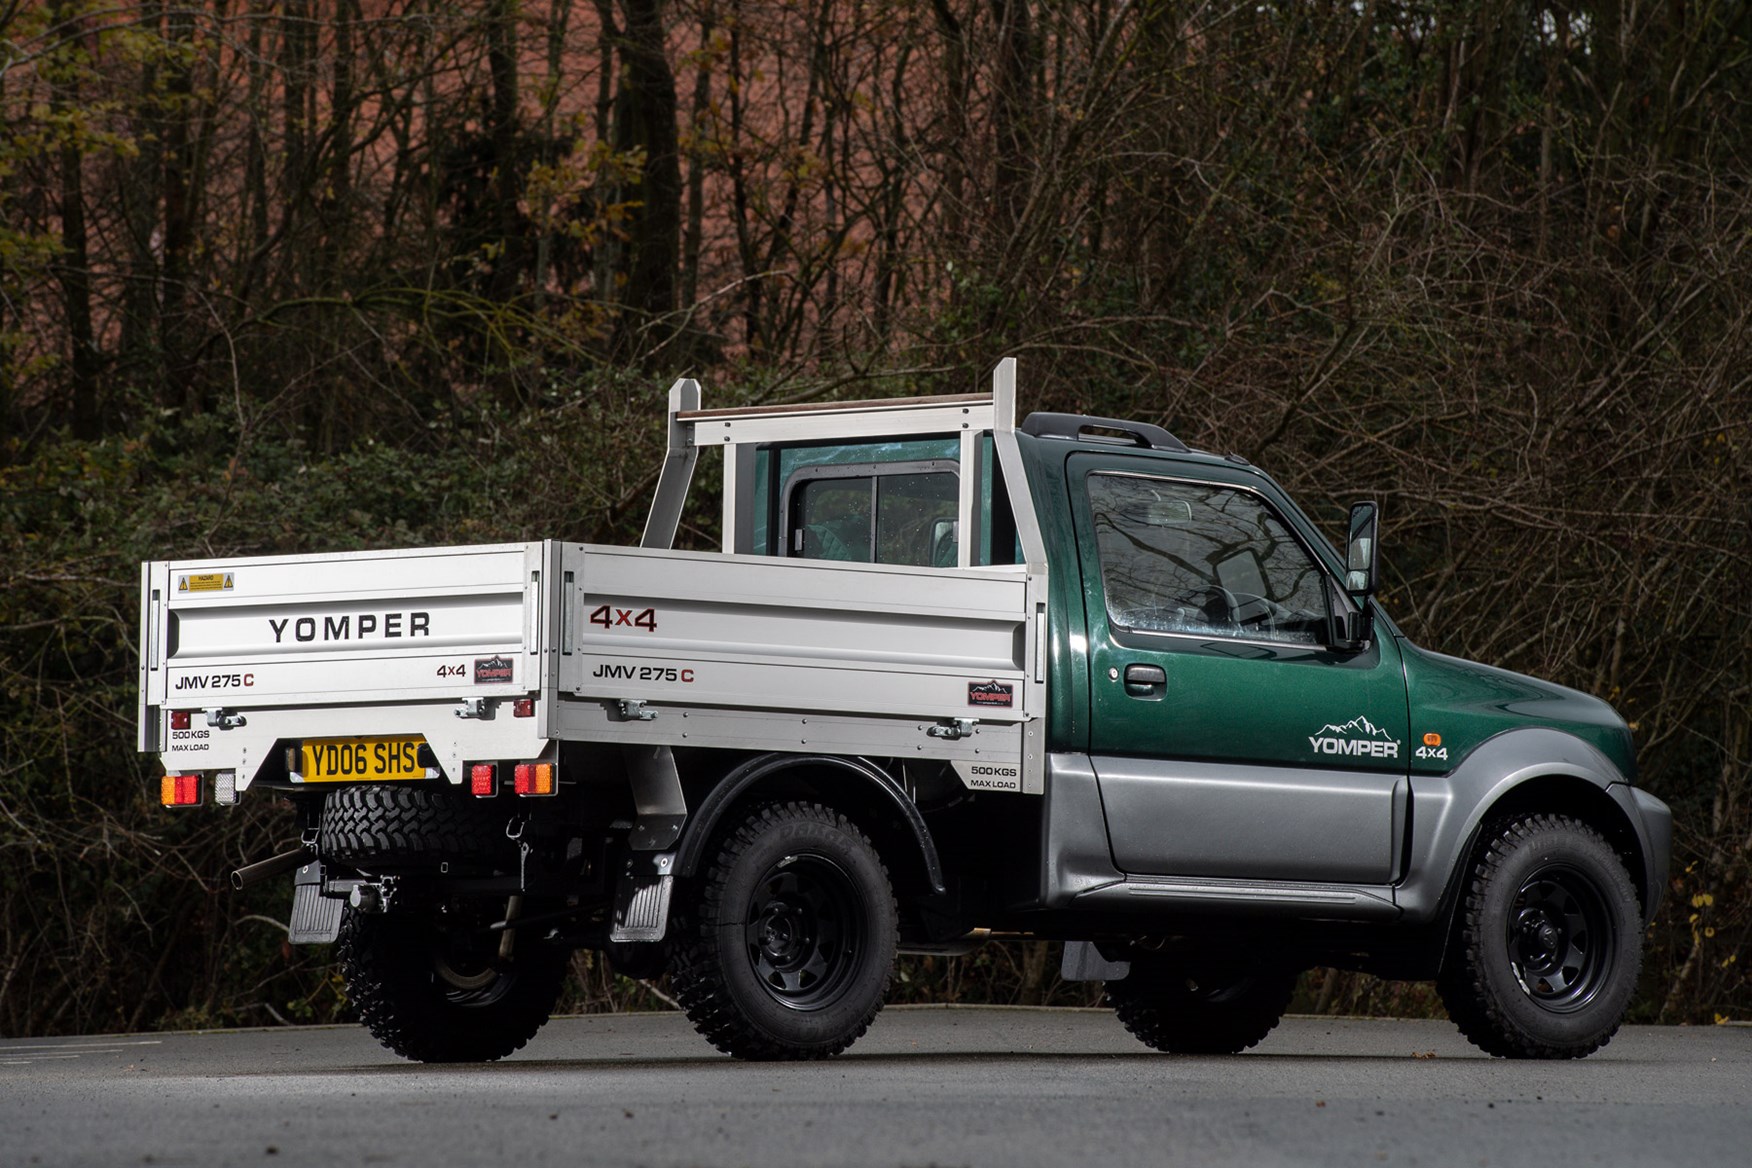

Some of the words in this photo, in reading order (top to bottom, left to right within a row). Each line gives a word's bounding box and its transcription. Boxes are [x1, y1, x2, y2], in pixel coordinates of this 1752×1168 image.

[589, 605, 658, 633] 4x4
[268, 611, 431, 643] YOMPER
[436, 663, 467, 679] 4x4
[476, 668, 512, 678] YOMPER
[592, 664, 637, 680] JMV
[640, 666, 678, 682] 275
[681, 668, 695, 683] C
[175, 675, 209, 690] JMV
[211, 674, 241, 688] 275
[243, 673, 254, 687] C
[969, 691, 1012, 702] YOMPER
[172, 731, 190, 740] 500
[191, 730, 210, 739] KGS
[171, 744, 188, 752] MAX
[189, 743, 210, 751] LOAD
[1308, 736, 1399, 759] YOMPER
[1415, 746, 1449, 761] 4x4
[312, 743, 367, 776] YD06
[374, 741, 415, 774] SHS
[971, 766, 993, 775] 500
[994, 767, 1017, 777] KGS
[970, 779, 991, 788] MAX
[992, 780, 1016, 789] LOAD
